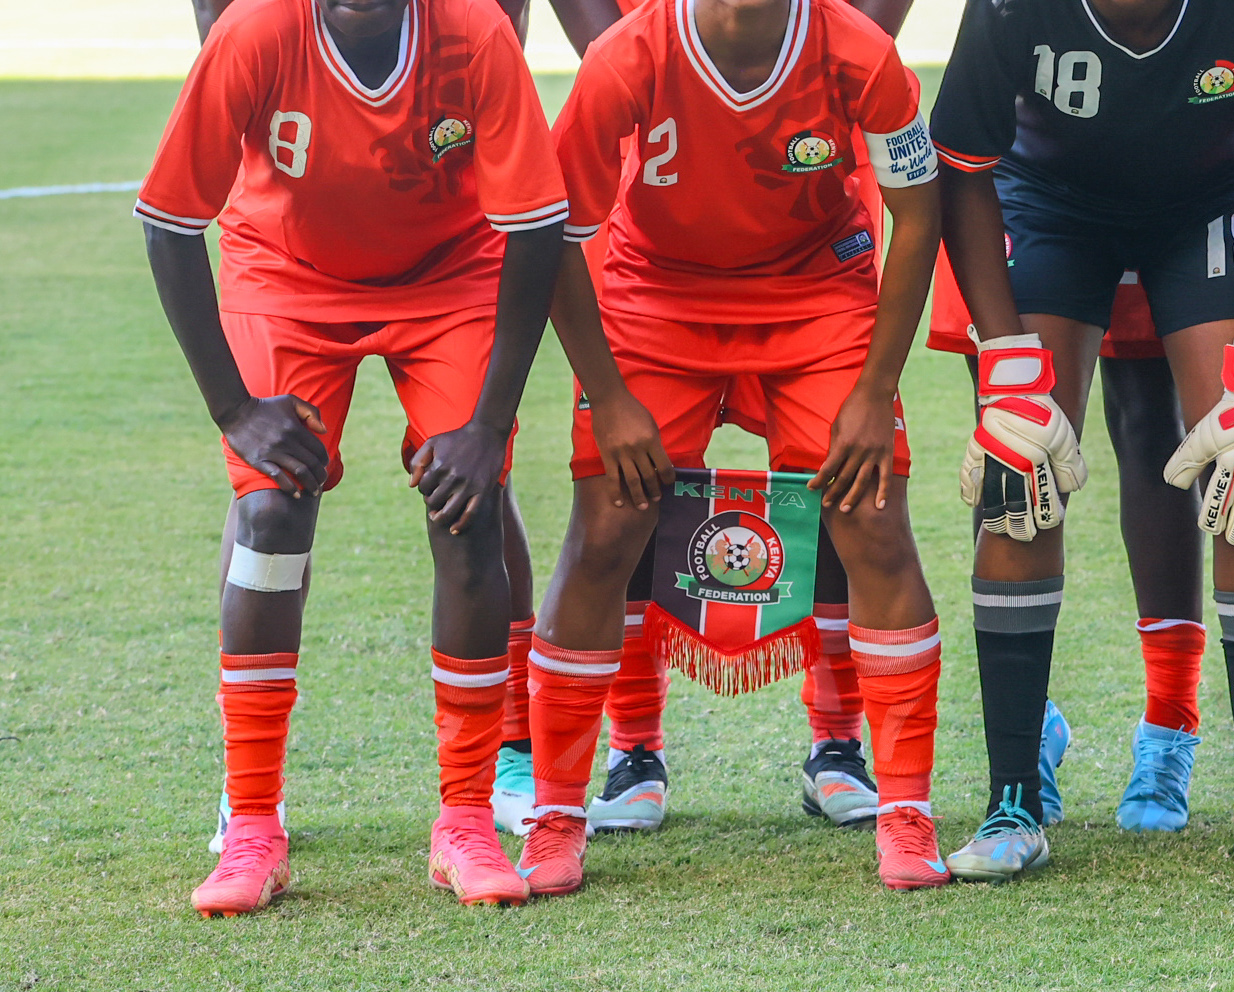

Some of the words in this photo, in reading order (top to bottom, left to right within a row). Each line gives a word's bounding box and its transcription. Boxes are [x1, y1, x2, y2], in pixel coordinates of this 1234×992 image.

[1033, 44, 1102, 119] 18
[268, 109, 312, 179] 8
[787, 136, 800, 165] FOOTBALL
[885, 121, 924, 148] FOOTBALL
[888, 130, 928, 161] UNITES
[643, 117, 679, 187] 2
[792, 162, 833, 172] FEDERATION
[888, 161, 909, 175] the
[908, 141, 933, 170] World
[907, 166, 928, 182] FIFA
[674, 481, 806, 509] KENYA
[1036, 462, 1051, 512] KELME
[1205, 479, 1228, 529] KELME
[693, 522, 721, 582] FOOTBALL
[764, 536, 781, 580] KENYA
[697, 587, 771, 602] FEDERATION
